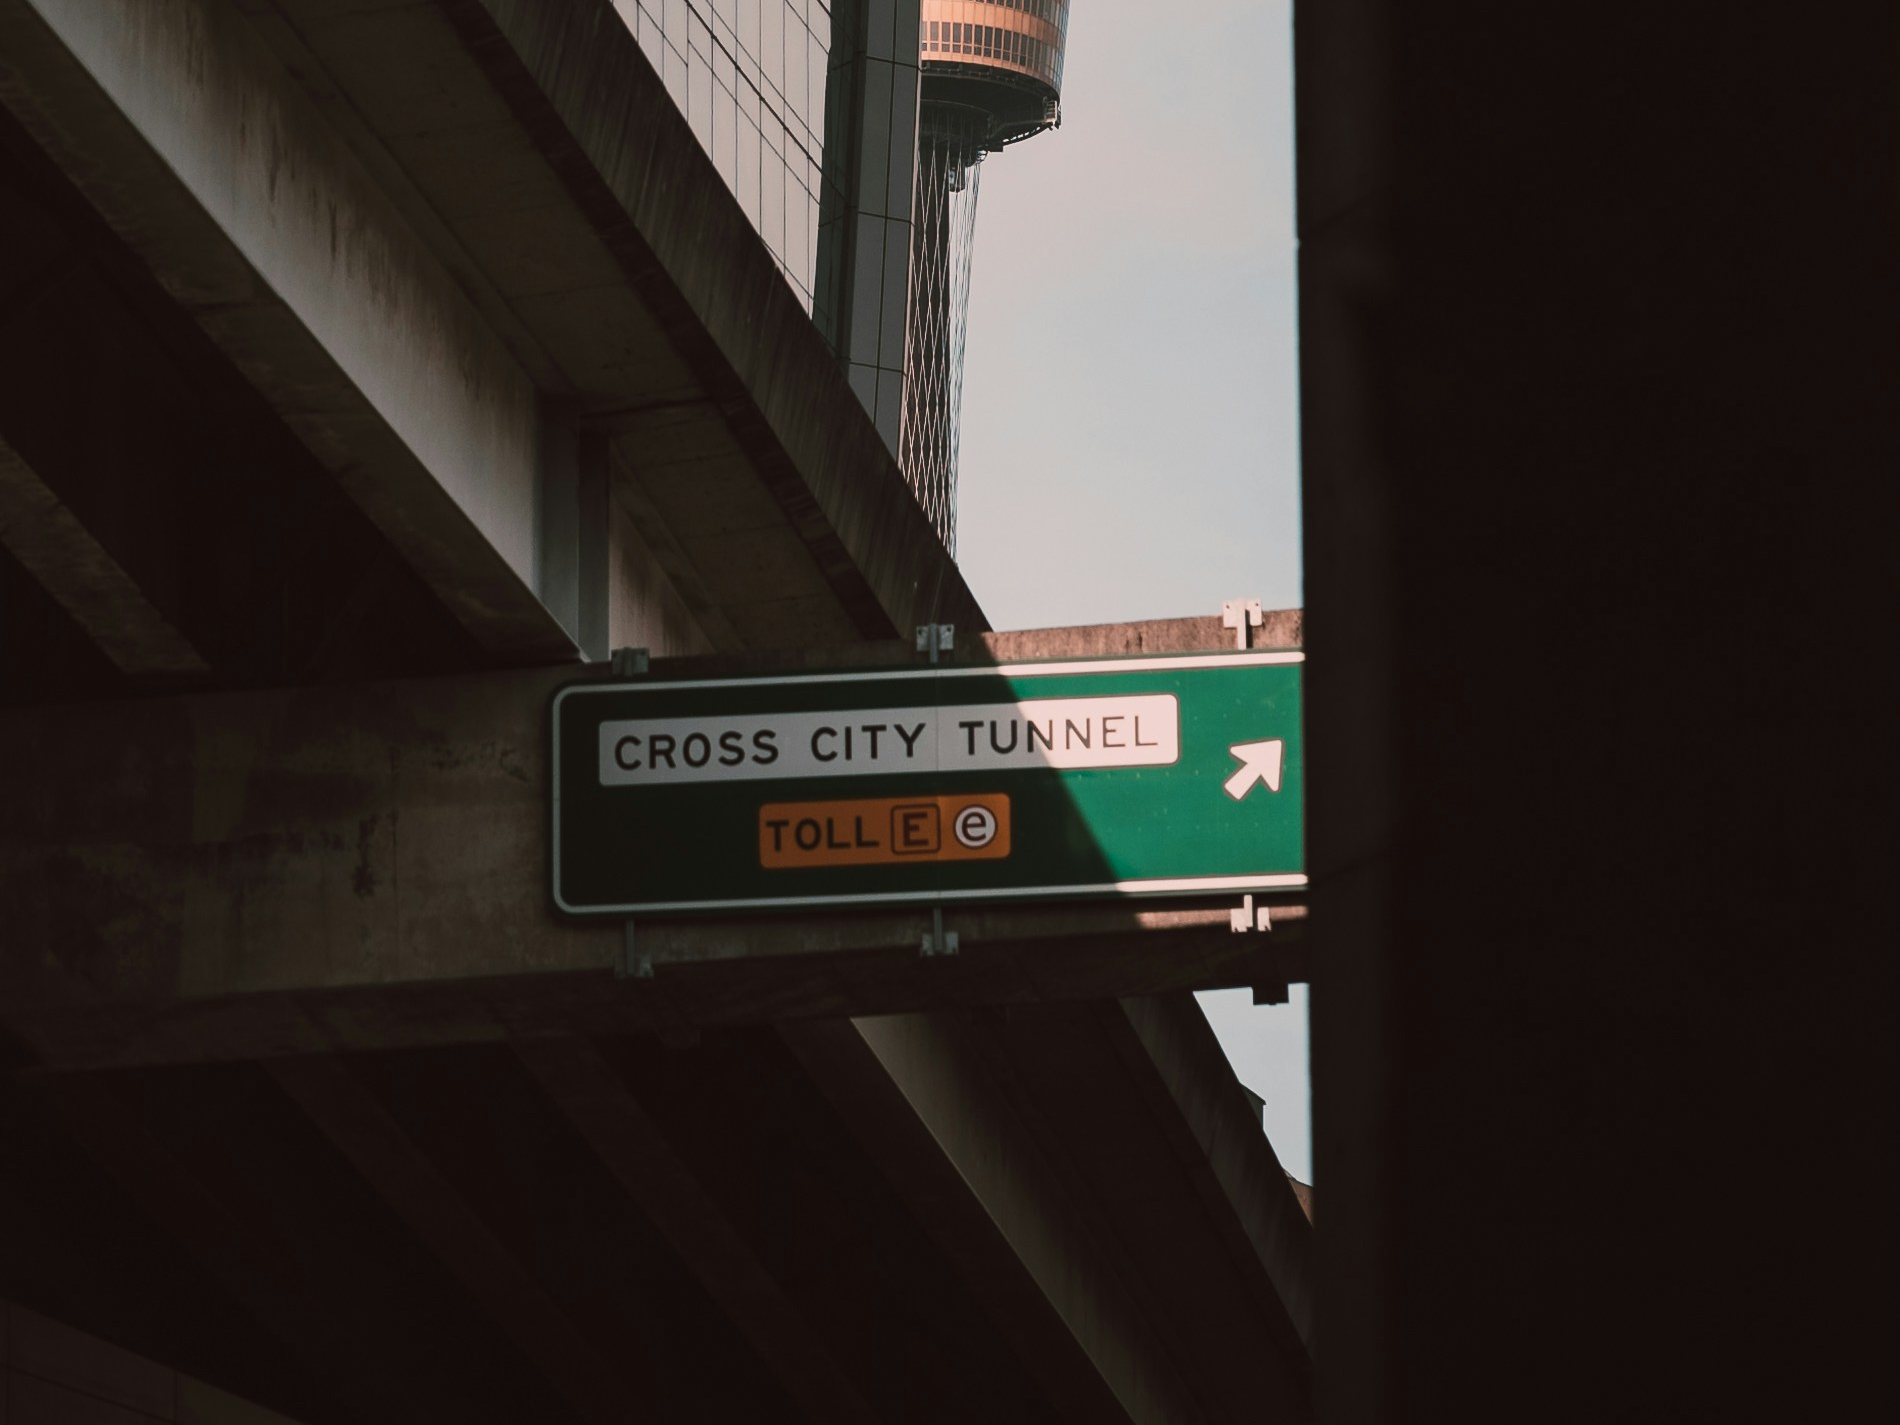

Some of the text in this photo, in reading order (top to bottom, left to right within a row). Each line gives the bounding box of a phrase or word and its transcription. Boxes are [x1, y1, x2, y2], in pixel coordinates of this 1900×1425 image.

[614, 715, 1159, 771] CROSS CITY TUNNEL
[765, 810, 988, 852] TOLL E e
